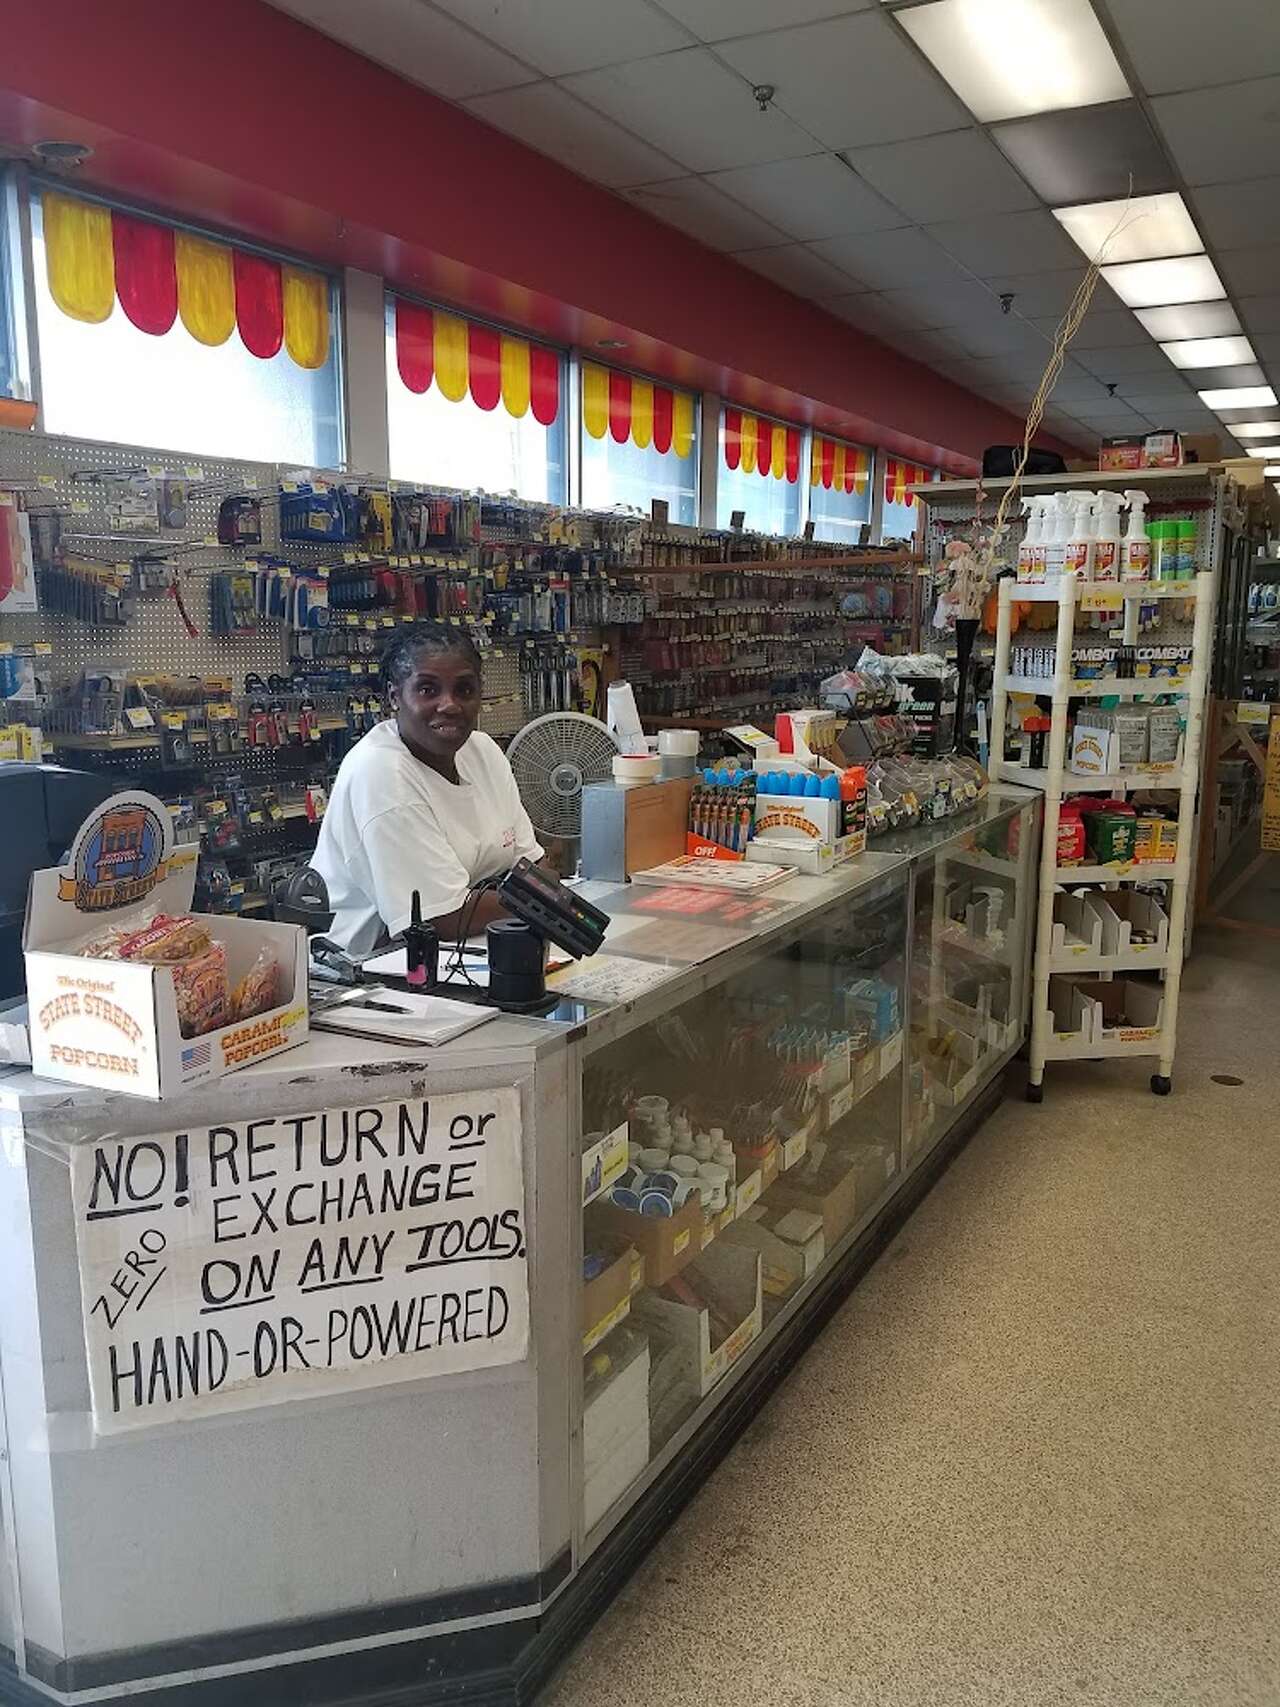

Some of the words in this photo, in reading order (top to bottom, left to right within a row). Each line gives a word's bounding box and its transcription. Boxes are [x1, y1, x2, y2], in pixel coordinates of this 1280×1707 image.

[1137, 647, 1192, 660] COMBAT
[694, 846, 717, 858] OFF!
[39, 992, 81, 1032] STATE
[83, 993, 143, 1044] STREET
[76, 977, 115, 993] Original
[50, 1043, 139, 1077] POPCORN
[87, 1135, 190, 1209] NO!
[208, 1101, 430, 1187] RETURN
[450, 1112, 496, 1141] or
[213, 1161, 477, 1243] EXCHANGE
[91, 1228, 167, 1329] ZERO
[200, 1249, 280, 1305] ON
[298, 1230, 395, 1287] ANY
[407, 1210, 526, 1262] TOOLS.
[108, 1286, 509, 1412] HAND-OR-POWERED
